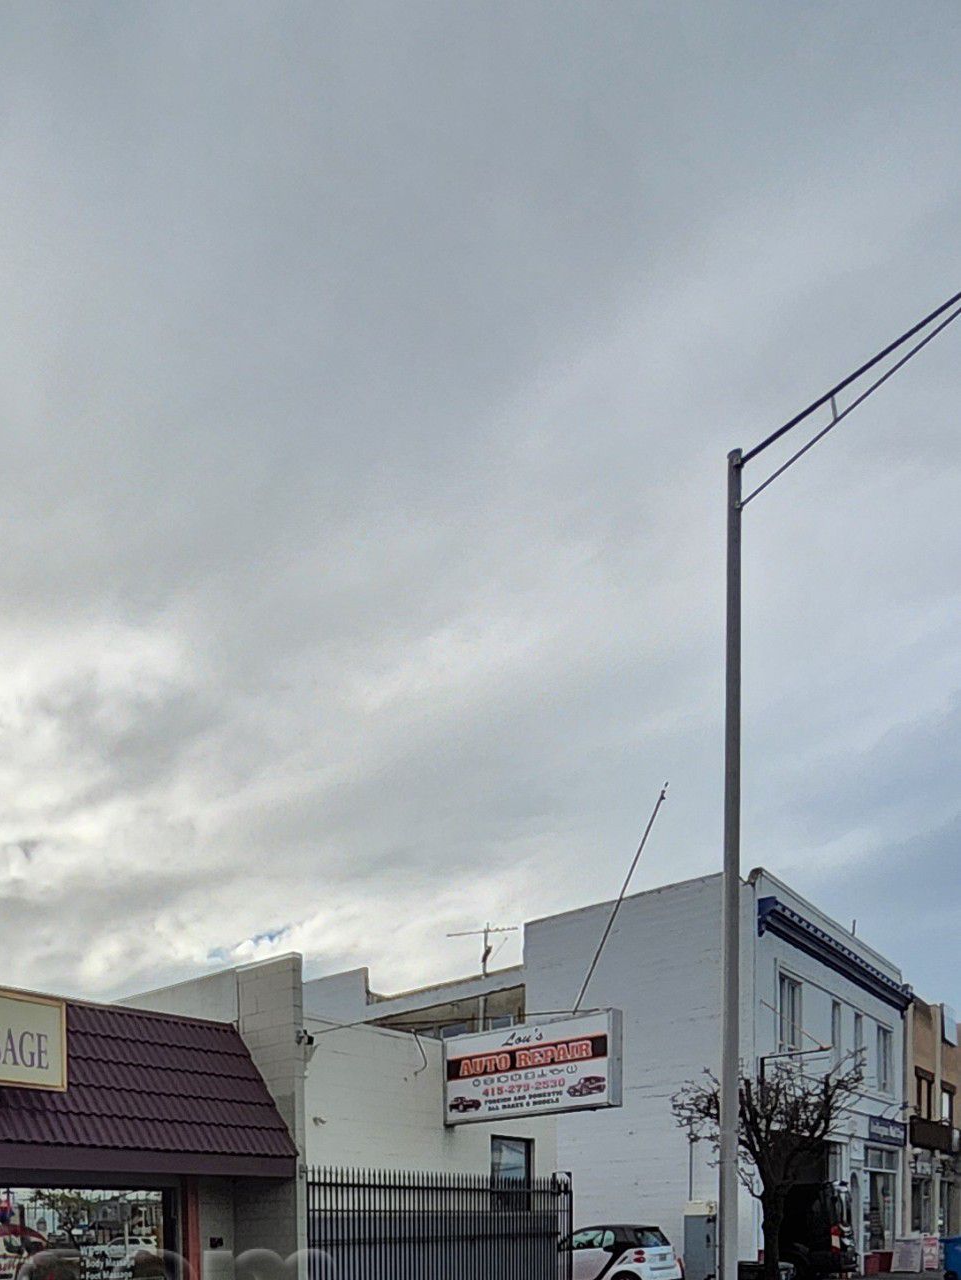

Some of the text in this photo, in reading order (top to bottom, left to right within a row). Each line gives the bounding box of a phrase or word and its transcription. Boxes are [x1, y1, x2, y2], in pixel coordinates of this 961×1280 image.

[501, 1027, 543, 1046] Lou's
[459, 1039, 593, 1077] AUTO REPAIR
